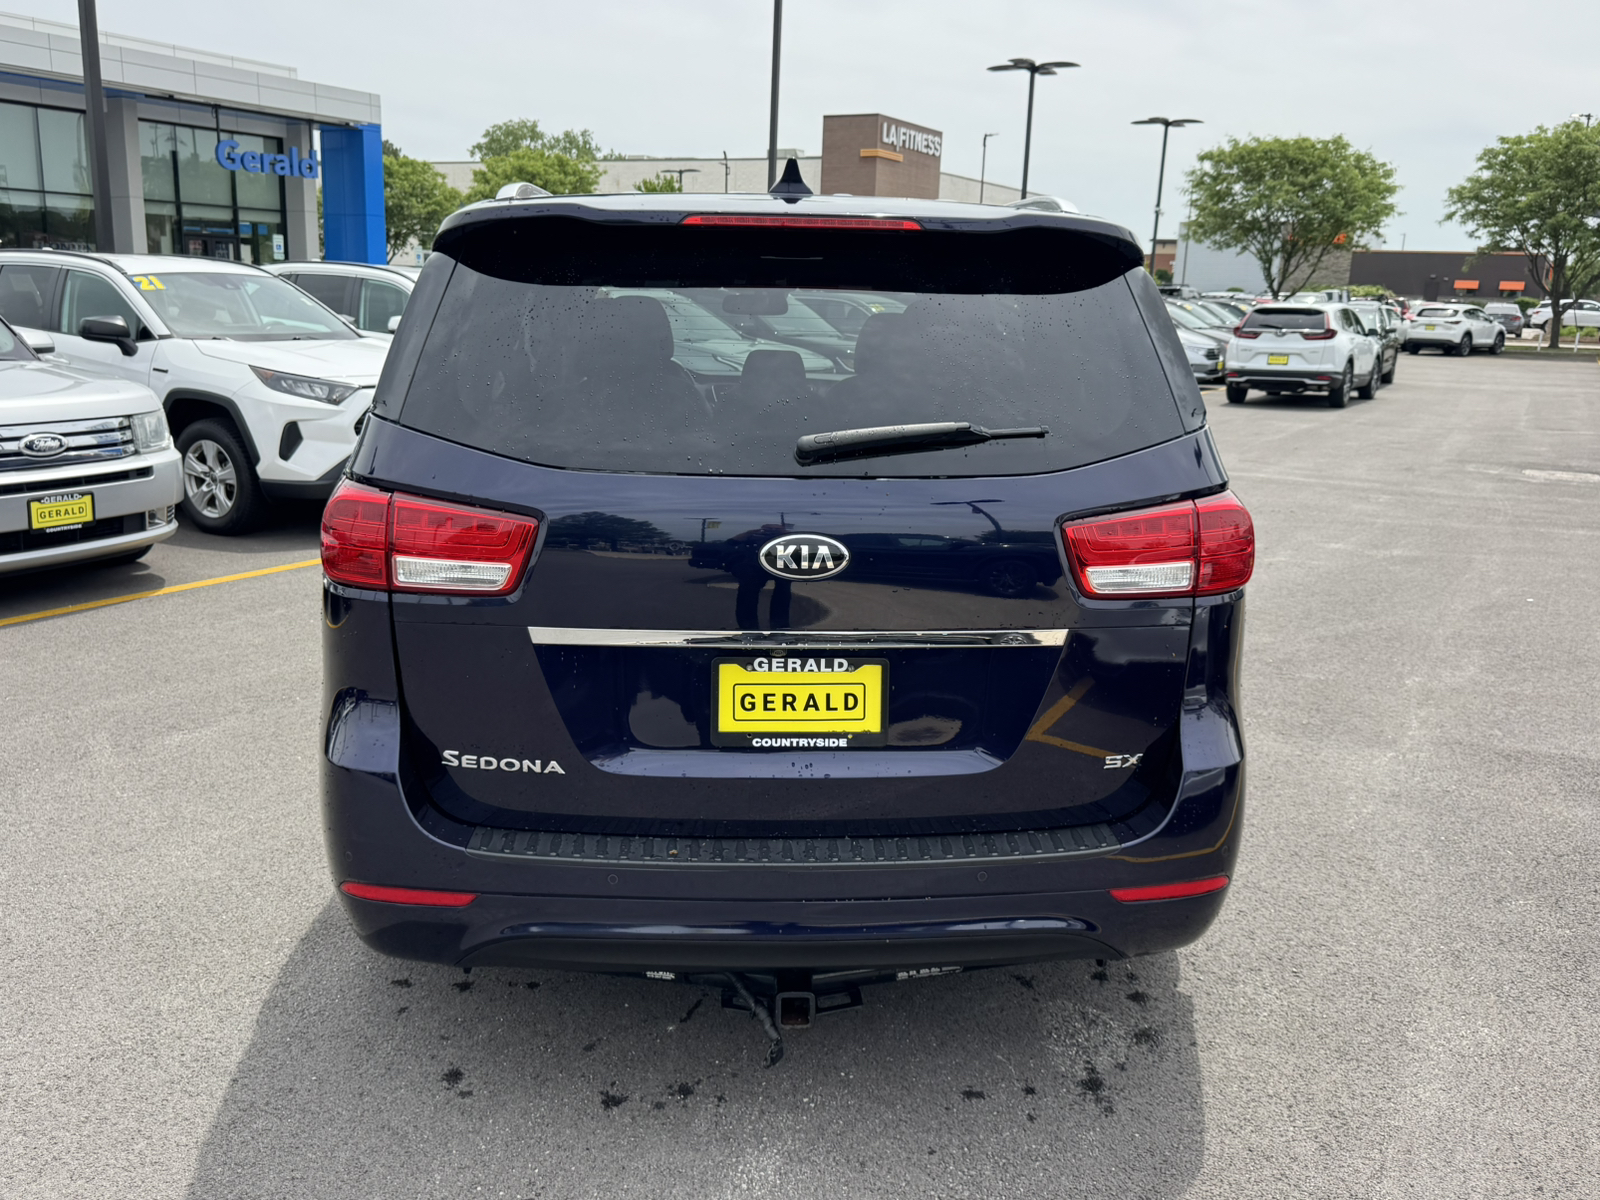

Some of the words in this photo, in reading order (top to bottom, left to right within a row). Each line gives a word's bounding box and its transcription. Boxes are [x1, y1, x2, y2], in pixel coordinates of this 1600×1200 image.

[882, 121, 897, 146] LA
[900, 127, 941, 157] FITNESS
[215, 139, 318, 179] Gerald
[132, 275, 167, 291] 21
[44, 493, 80, 503] GERALD
[40, 506, 84, 519] GERALD
[775, 544, 835, 570] KIA
[752, 657, 849, 673] GERALD
[739, 692, 859, 712] GERALD
[752, 737, 848, 748] COUNTRYSIDE
[441, 749, 566, 775] SEDONA
[1103, 753, 1144, 770] SX
